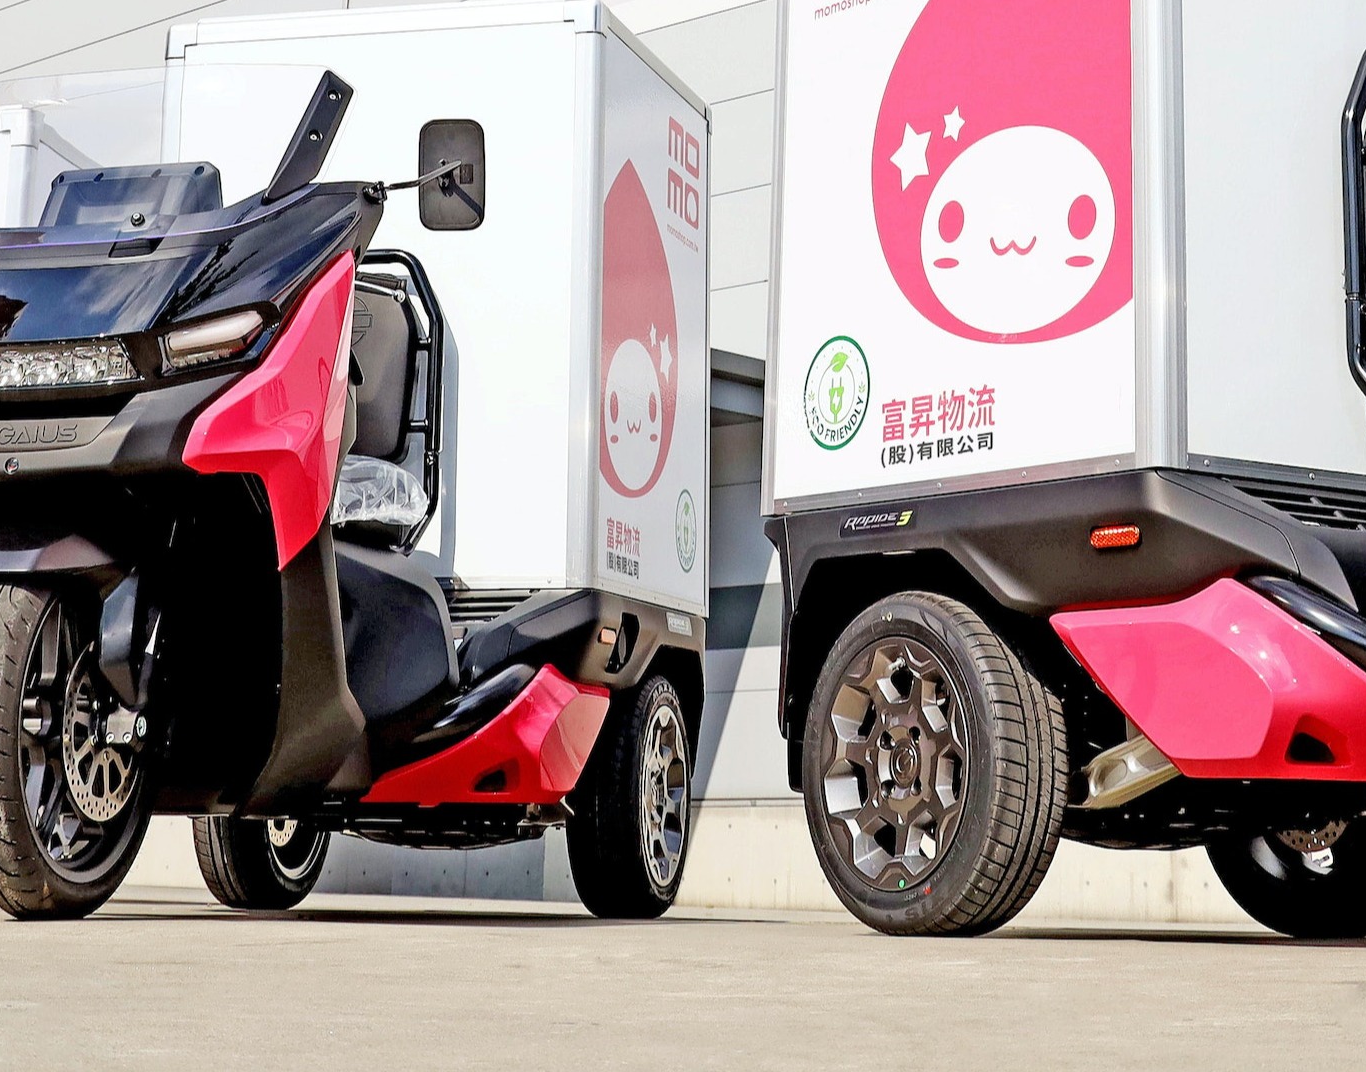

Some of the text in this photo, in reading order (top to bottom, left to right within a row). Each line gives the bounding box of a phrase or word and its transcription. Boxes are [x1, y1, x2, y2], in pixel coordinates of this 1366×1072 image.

[823, 395, 865, 443] FRIENDLY
[881, 384, 996, 443] 富昇物流
[880, 431, 994, 469] (股)有限公司
